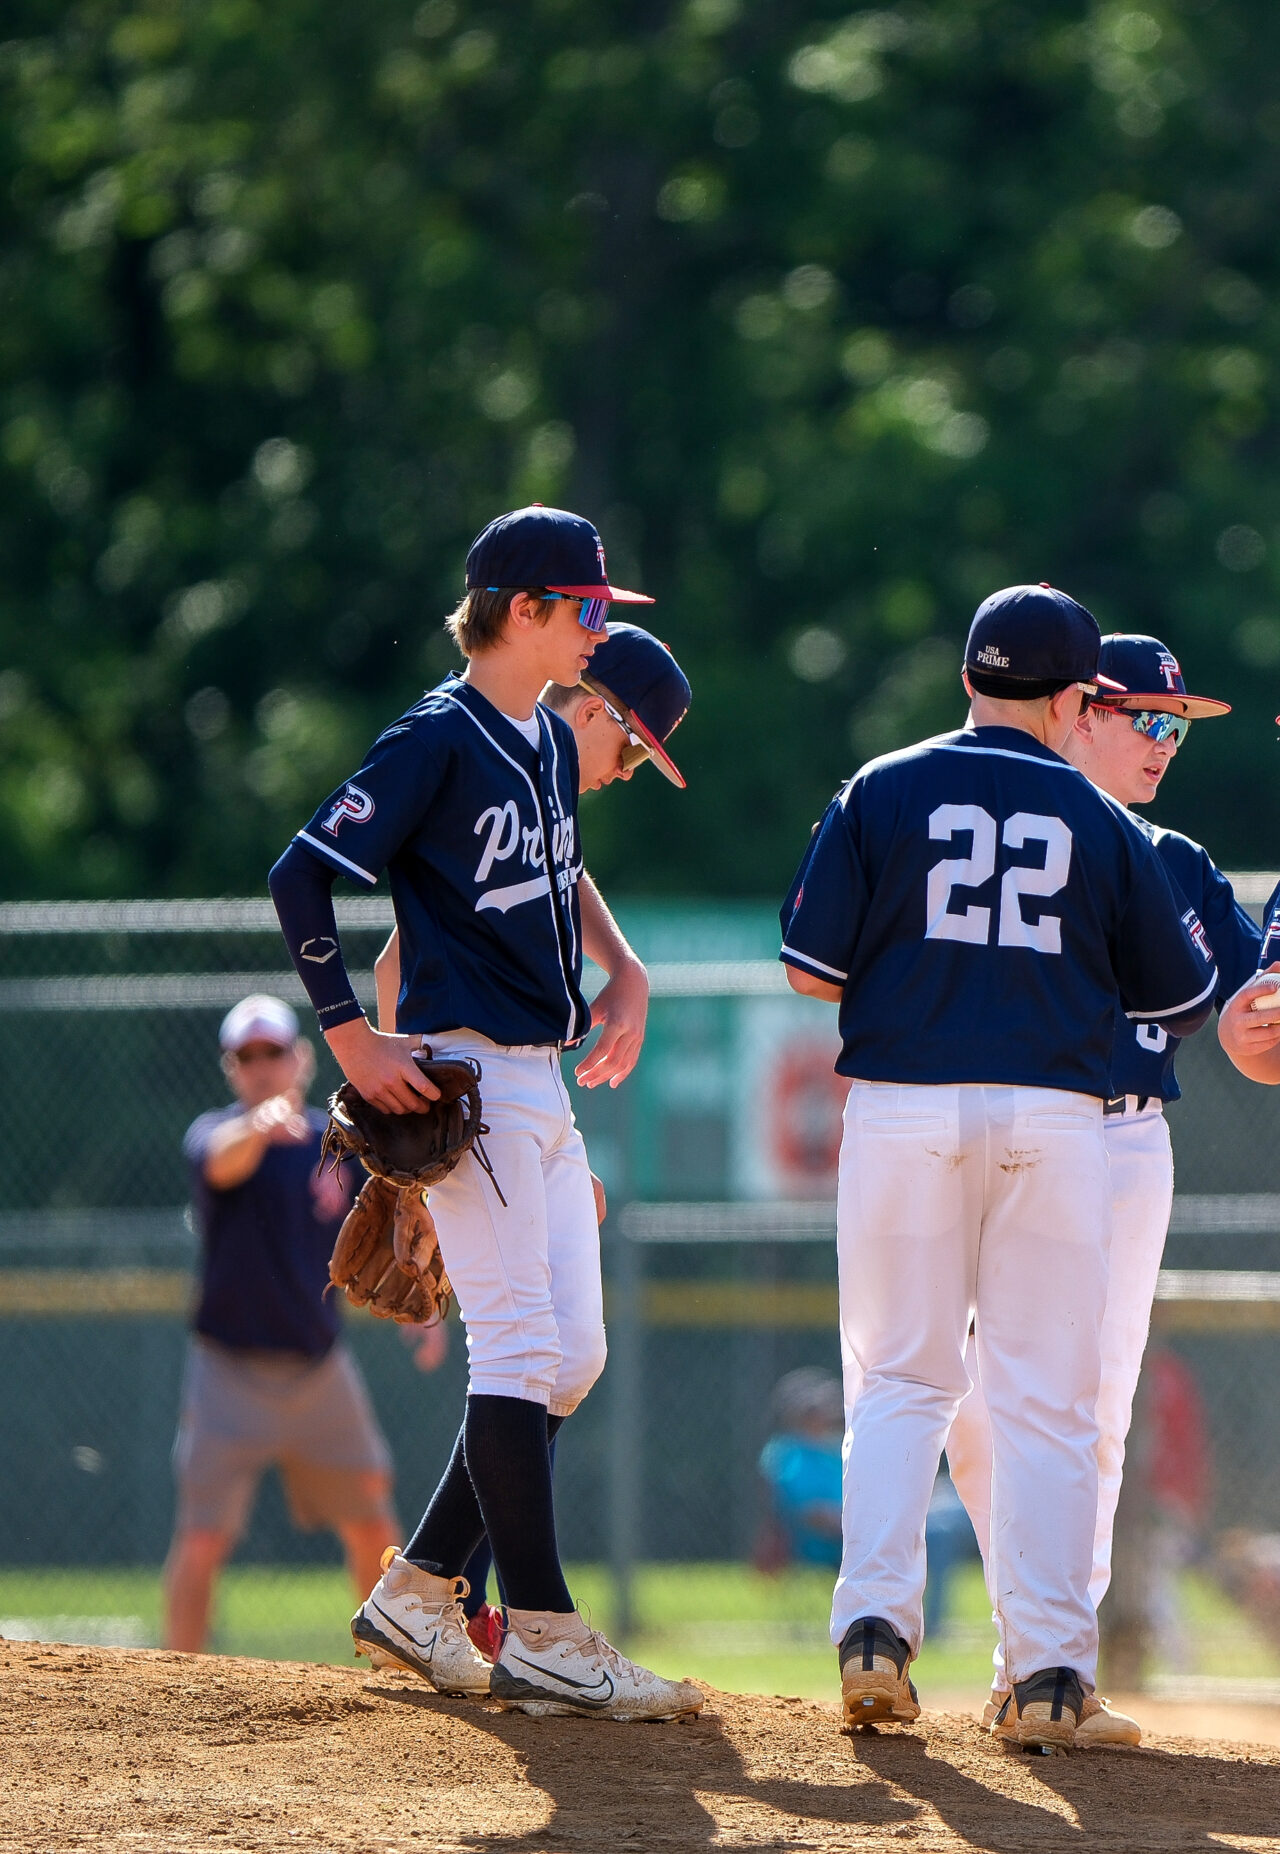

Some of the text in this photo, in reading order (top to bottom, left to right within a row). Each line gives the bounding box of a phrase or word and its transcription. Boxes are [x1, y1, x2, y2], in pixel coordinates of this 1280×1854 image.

[977, 650, 1010, 668] PRIME
[985, 645, 1000, 656] USA
[321, 782, 376, 837] P
[473, 799, 574, 883] Prim
[925, 803, 1073, 955] 22
